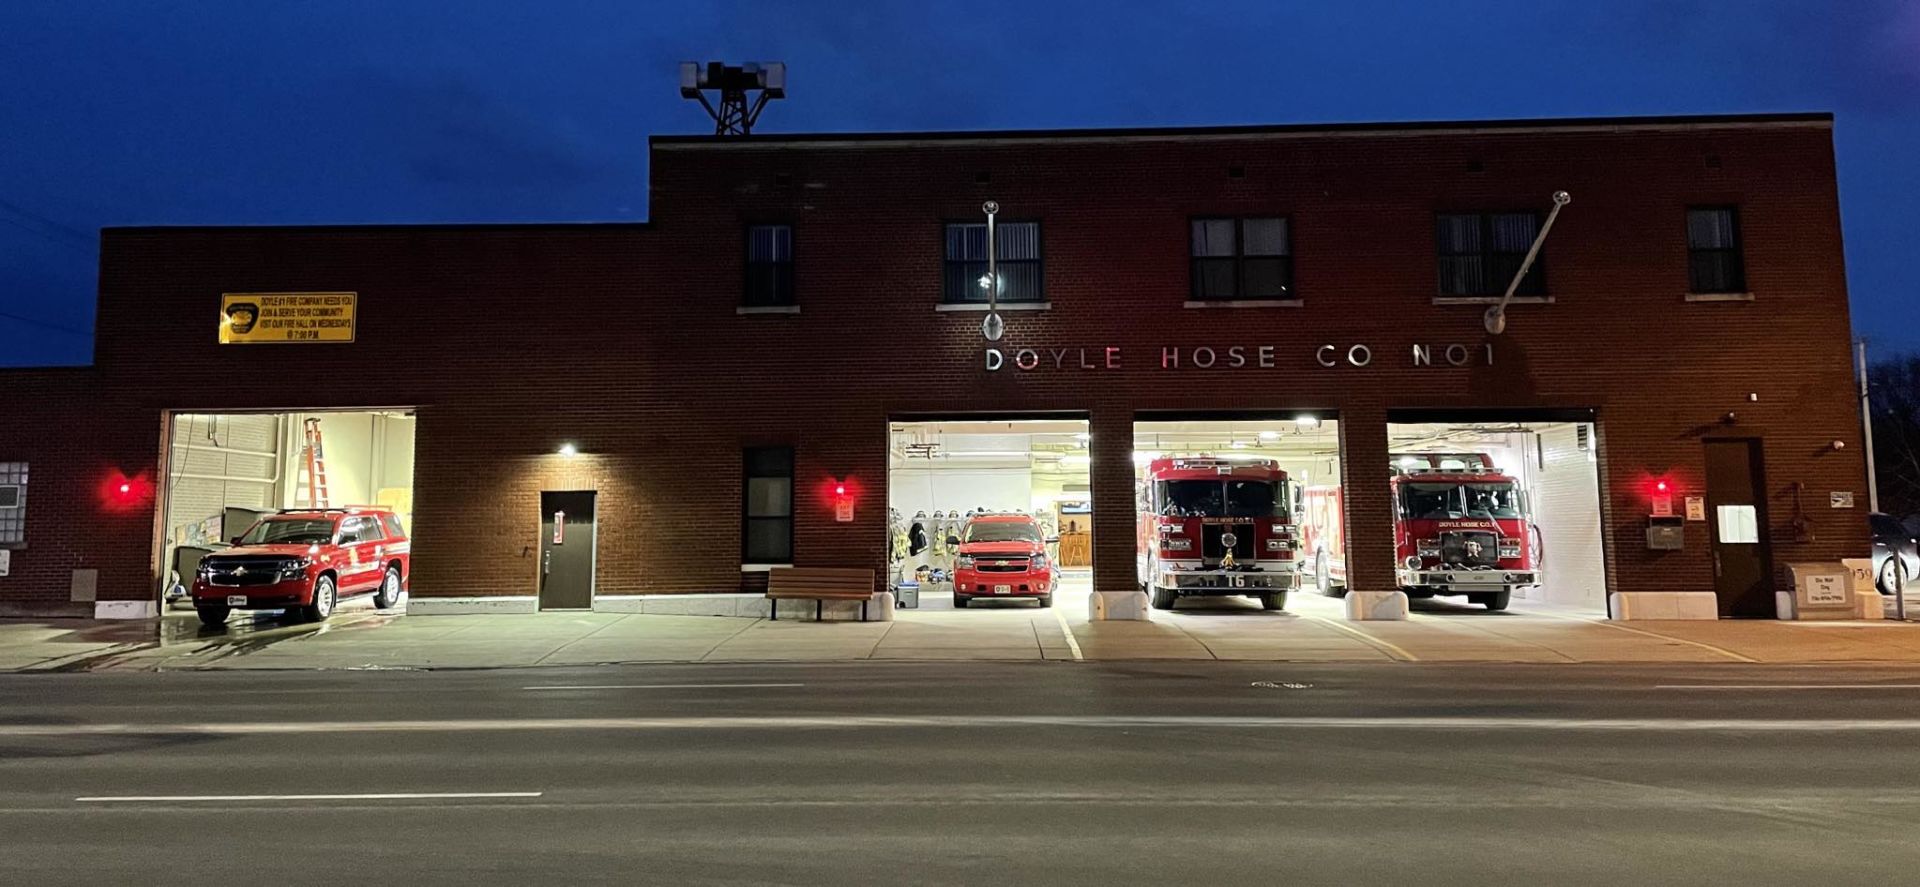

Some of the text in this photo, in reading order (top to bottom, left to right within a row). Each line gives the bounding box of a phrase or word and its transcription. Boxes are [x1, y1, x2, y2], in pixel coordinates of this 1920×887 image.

[261, 297, 278, 305] DOYLE
[286, 297, 298, 305] FIRE
[299, 297, 322, 305] COMPANY
[324, 296, 341, 305] NEEDS
[342, 296, 352, 305] YOU
[260, 308, 272, 317] JOIN
[279, 308, 296, 317] SERVE
[297, 308, 311, 317] YOUR
[312, 308, 343, 317] COMMUNITY
[260, 319, 351, 328] VISIT OUR FIRE HALL ON WEDNESDAYS
[985, 347, 1121, 372] DOYLE
[1162, 345, 1275, 369] HOSE
[1316, 344, 1371, 367] CO
[1225, 575, 1245, 587] T6
